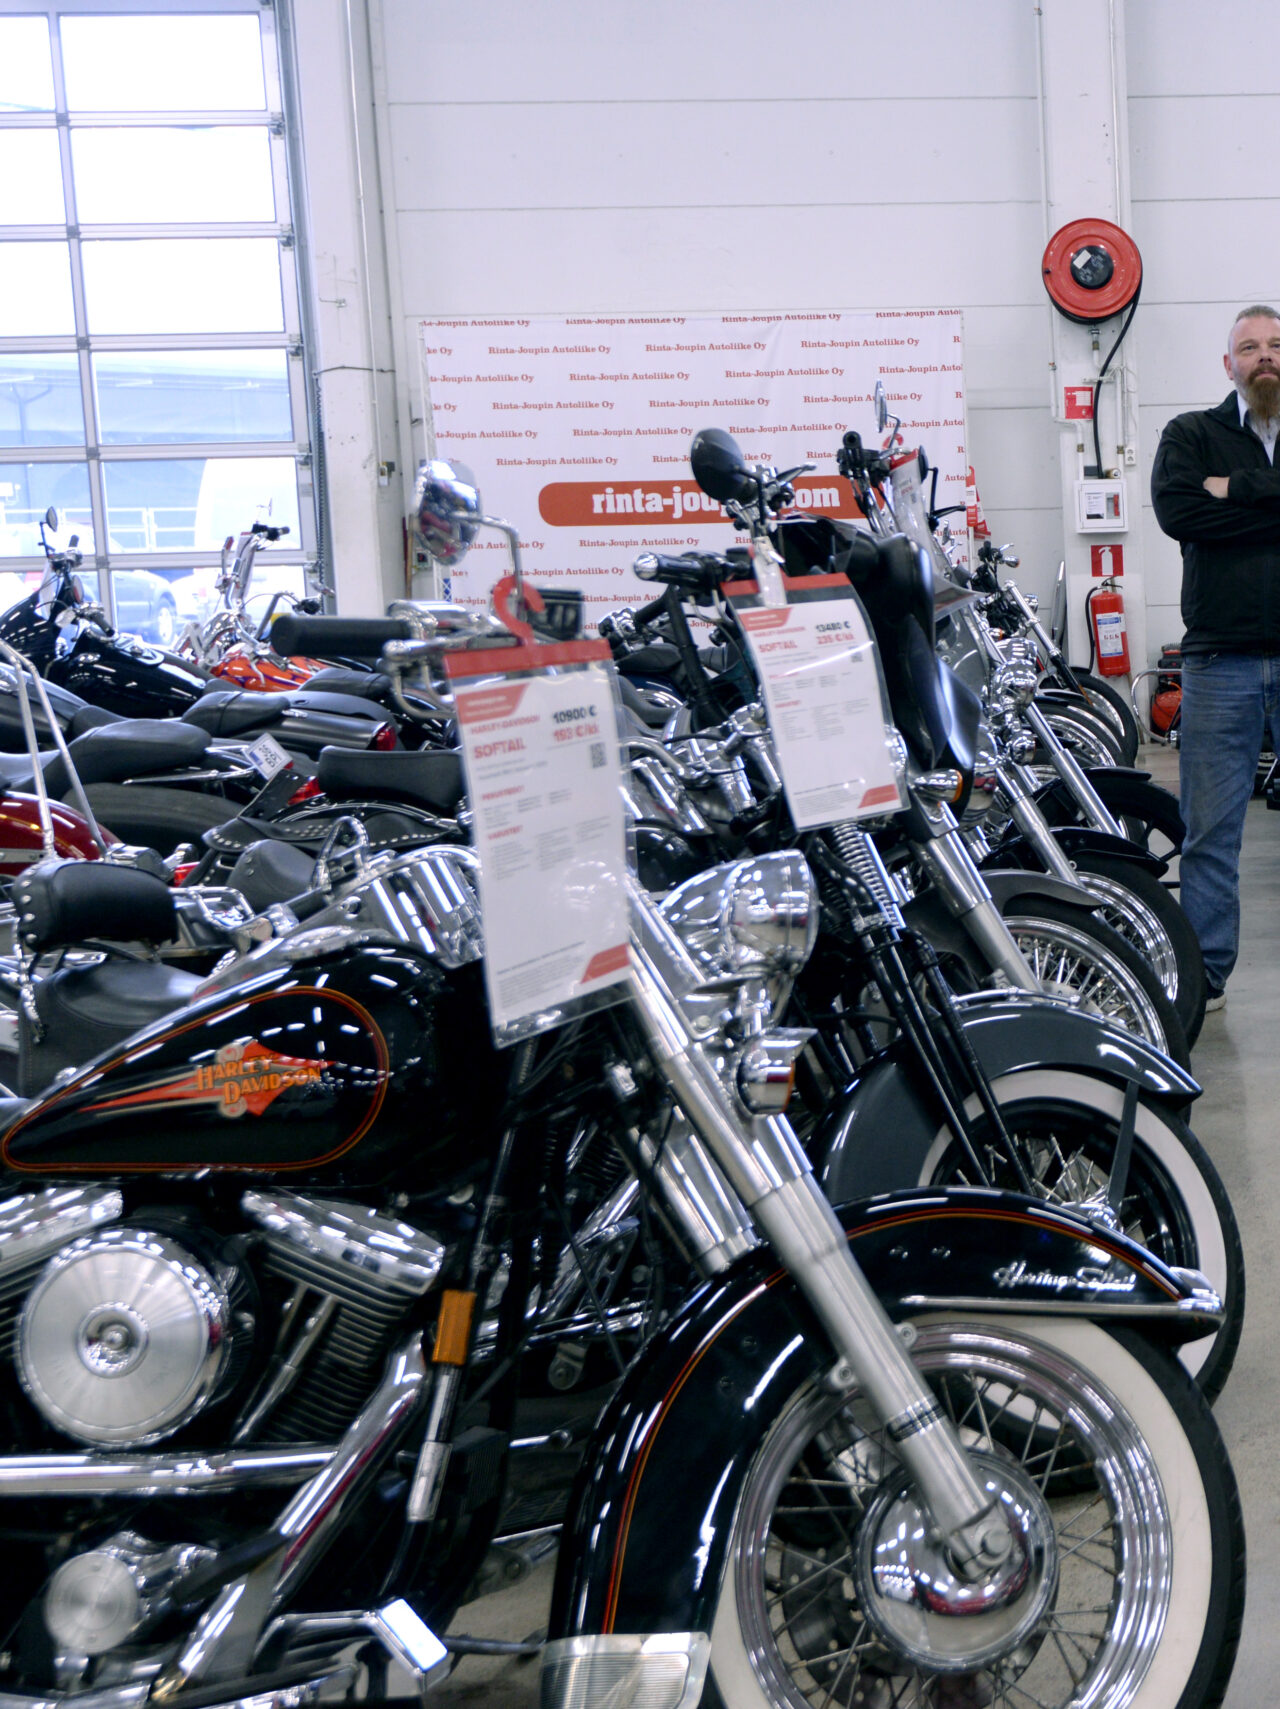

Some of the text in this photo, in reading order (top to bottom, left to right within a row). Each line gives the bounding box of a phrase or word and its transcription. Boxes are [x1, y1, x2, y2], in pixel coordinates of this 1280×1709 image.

[646, 342, 768, 352] Rinta-Joupin Autoliike Oy
[800, 337, 920, 349] Rinta-Joupin Autoliike Oy
[440, 347, 453, 356] Oy
[488, 345, 611, 355] Rinta-Joupin Autoliike Oy
[725, 368, 844, 378] Rinta-Joupin Autoliike Oy
[879, 365, 938, 374] Rinta-Joupin
[475, 374, 519, 382] Autoliike
[521, 374, 534, 383] Oy
[569, 371, 691, 381] Rinta-Joupin Autoliike Oy
[803, 395, 864, 403] Rinta-Joupin
[909, 392, 923, 402] Oy
[443, 403, 457, 412] Oy
[492, 400, 615, 410] Rinta-Joupin Autoliike Oy
[649, 398, 770, 408] Rinta-Joupin Autoliike Oy
[573, 427, 693, 437] Rinta-Joupin Autoliike Oy
[729, 422, 848, 434] Rinta-Joupin Autoliike Oy
[480, 430, 523, 438] Autoliike
[525, 430, 538, 439] Oy
[496, 456, 619, 467] Rinta-Joupin Autoliike Oy
[532, 541, 544, 549] Oy
[579, 537, 699, 547] Rinta-Joupin Autoliike Oy
[565, 567, 609, 576] Autoliike
[611, 567, 625, 576] Oy
[474, 737, 528, 759] SOFTAIL
[197, 1055, 272, 1091] HARLEY
[223, 1066, 322, 1105] DAVIDSON
